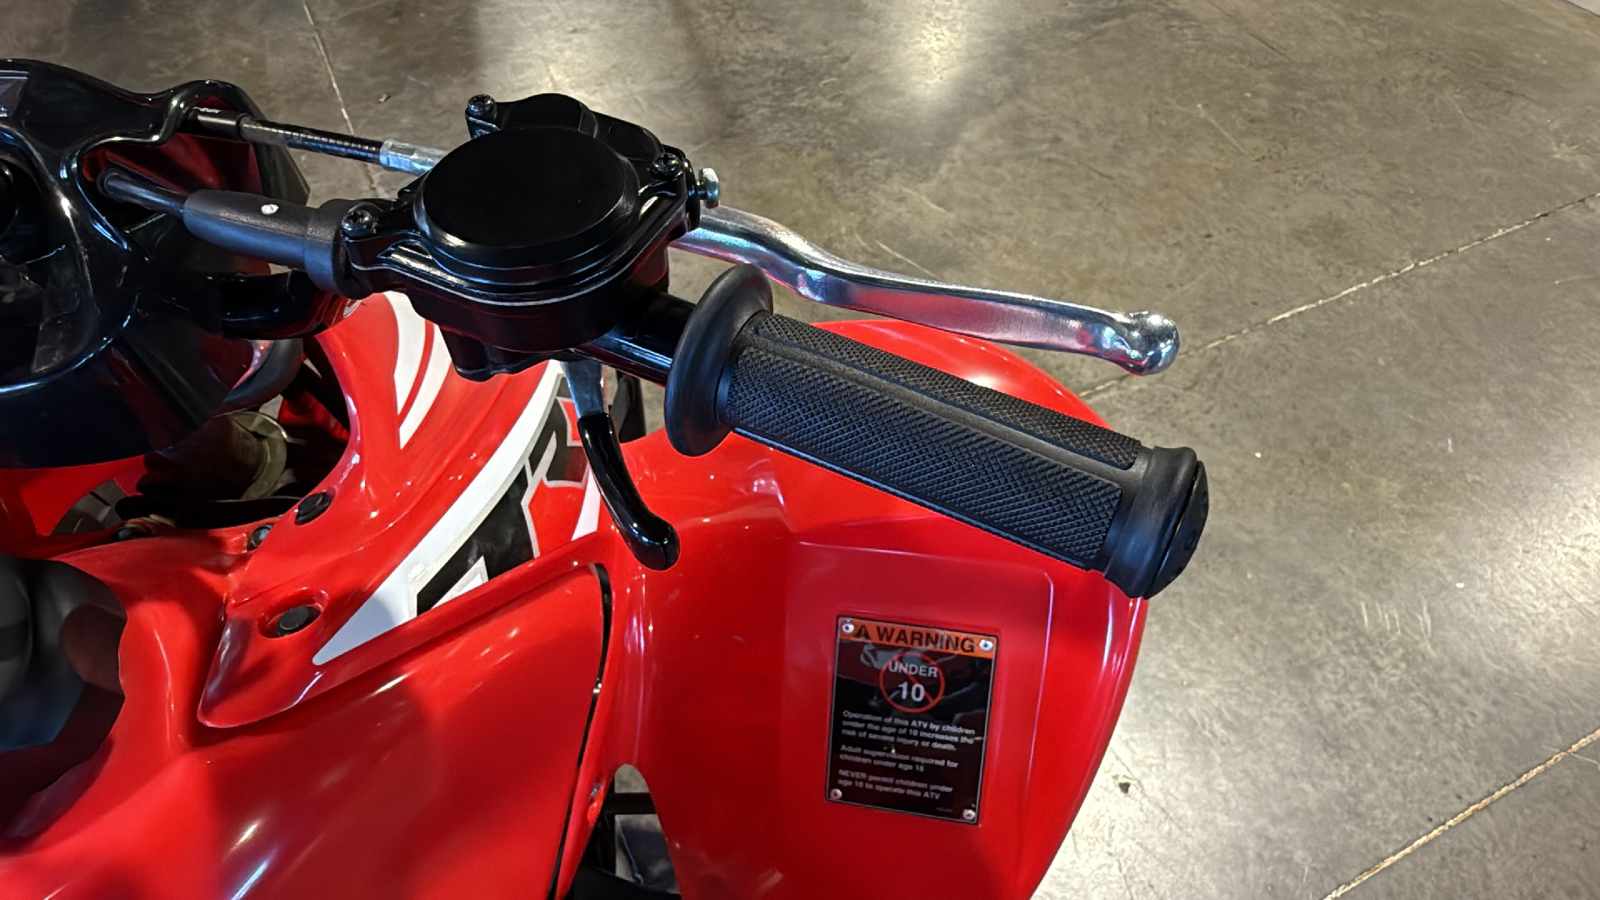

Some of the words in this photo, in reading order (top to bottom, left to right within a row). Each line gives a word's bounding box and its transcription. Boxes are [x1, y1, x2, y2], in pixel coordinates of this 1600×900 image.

[876, 626, 975, 653] WARNING
[888, 661, 938, 678] UNDER
[898, 681, 925, 702] 10
[842, 710, 882, 721] Operation
[883, 716, 893, 724] of
[911, 720, 928, 729] ATV
[930, 722, 940, 732] by
[941, 725, 975, 735] children
[842, 720, 866, 728] under
[867, 723, 880, 731] the
[881, 726, 896, 734] age
[909, 729, 919, 737] 10
[920, 731, 959, 743] increases
[960, 736, 974, 745] the
[896, 736, 919, 747] injury
[840, 754, 872, 764] children
[873, 760, 897, 768] under
[898, 763, 913, 771] age
[841, 744, 862, 753] Adult
[911, 756, 946, 767] required
[946, 760, 959, 768] for
[838, 769, 867, 780] NEVER
[868, 775, 894, 784] permit
[895, 779, 928, 789] children
[929, 784, 953, 793] under
[838, 779, 853, 787] age
[855, 780, 864, 788] 10
[875, 784, 905, 794] operate
[906, 788, 921, 797] this
[923, 791, 941, 800] ATV
